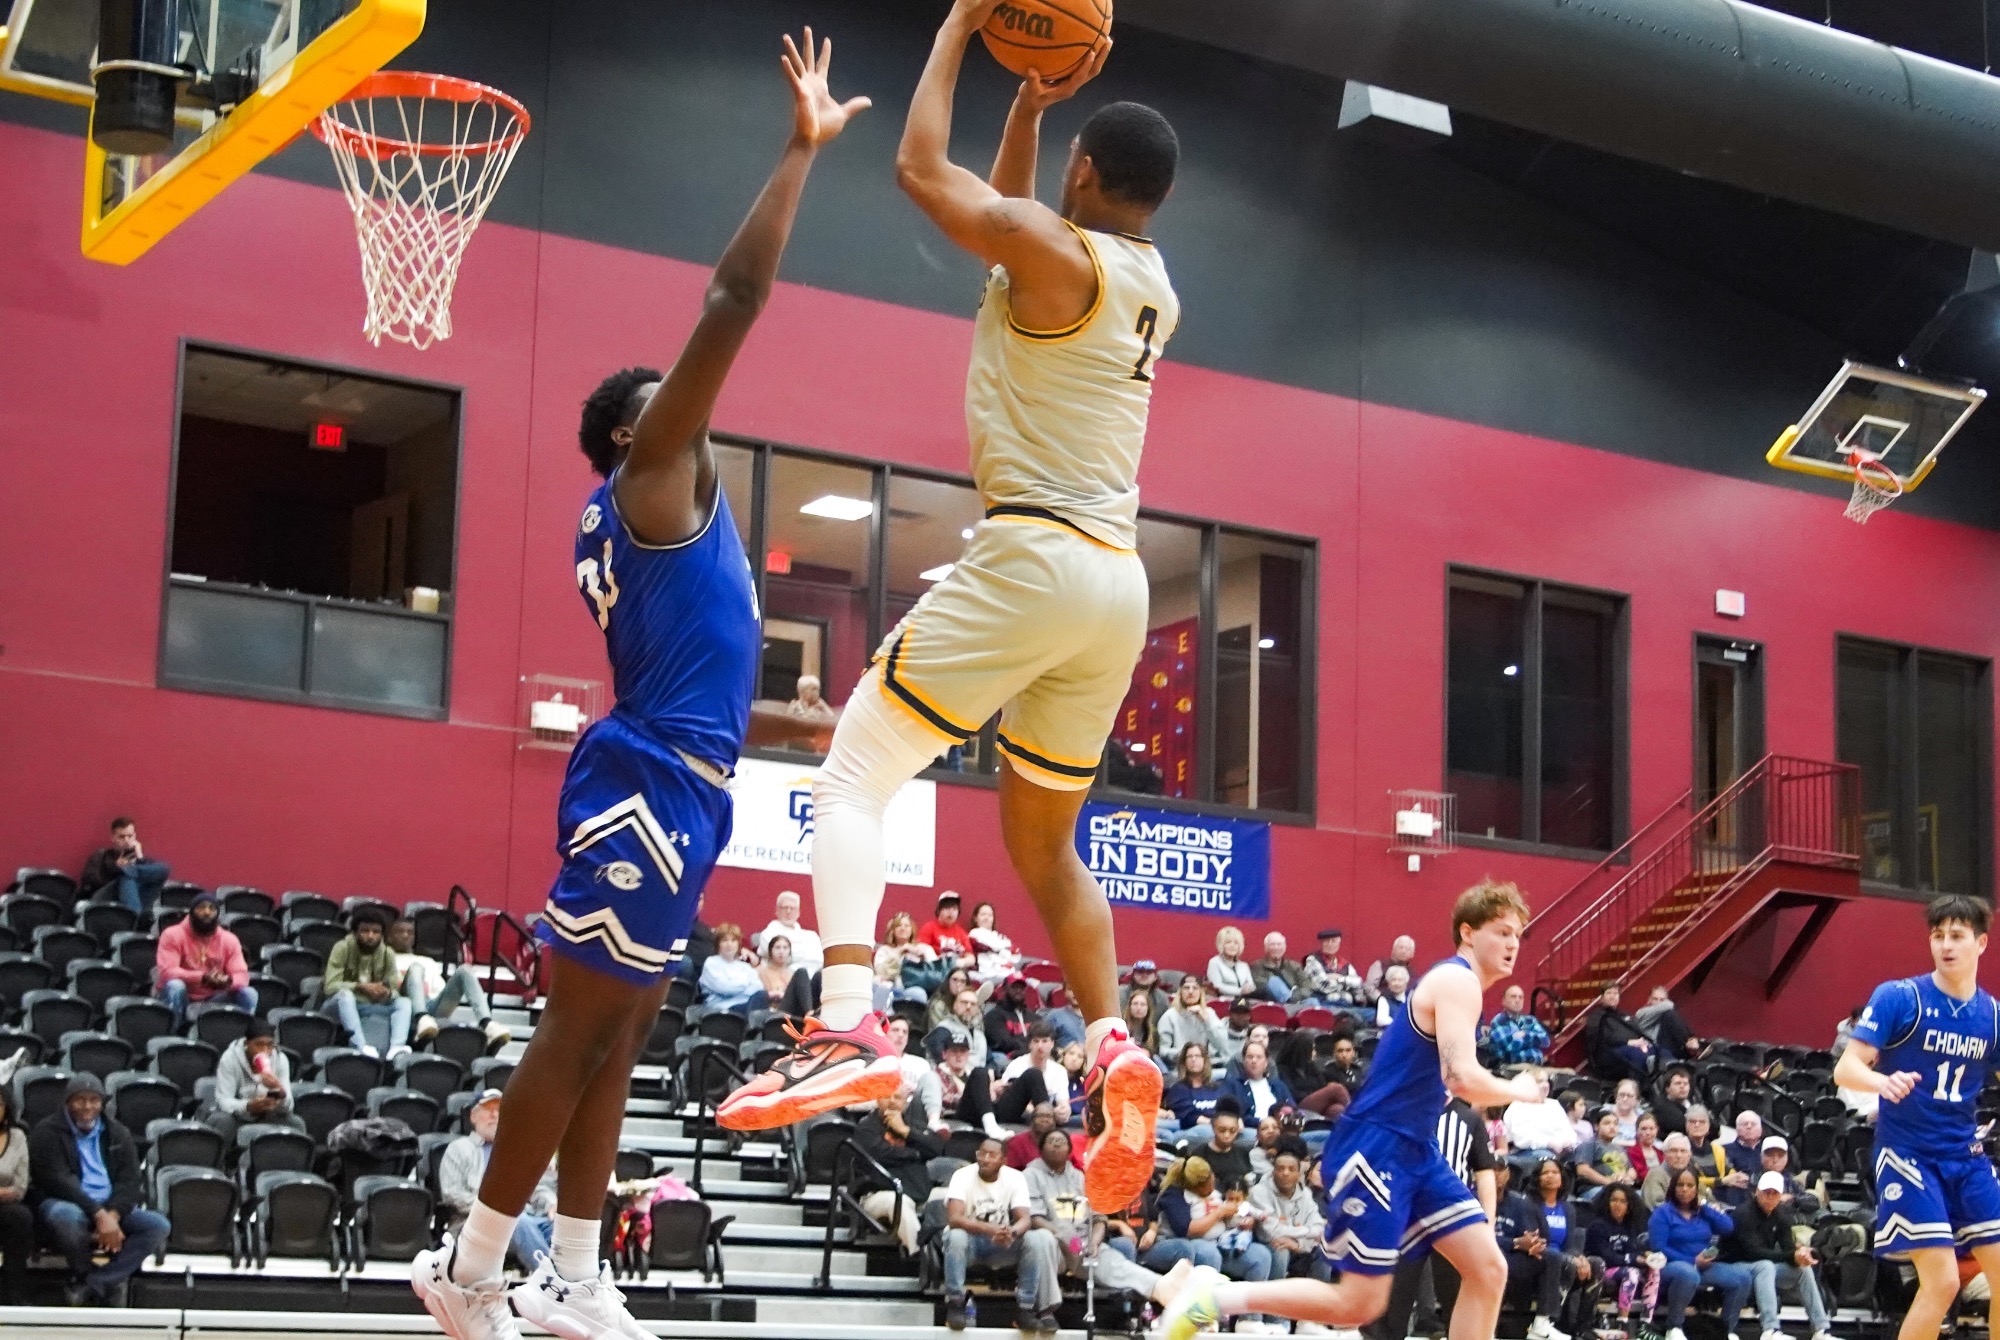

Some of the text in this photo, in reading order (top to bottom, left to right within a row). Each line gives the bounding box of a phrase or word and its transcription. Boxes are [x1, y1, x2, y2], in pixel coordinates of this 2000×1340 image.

[1089, 812, 1233, 850] CHAMPIONS
[1088, 842, 1232, 885] IN BODY,
[1151, 884, 1169, 904] &
[1923, 1029, 1987, 1060] CHOWAN
[1933, 1061, 1966, 1102] 11
